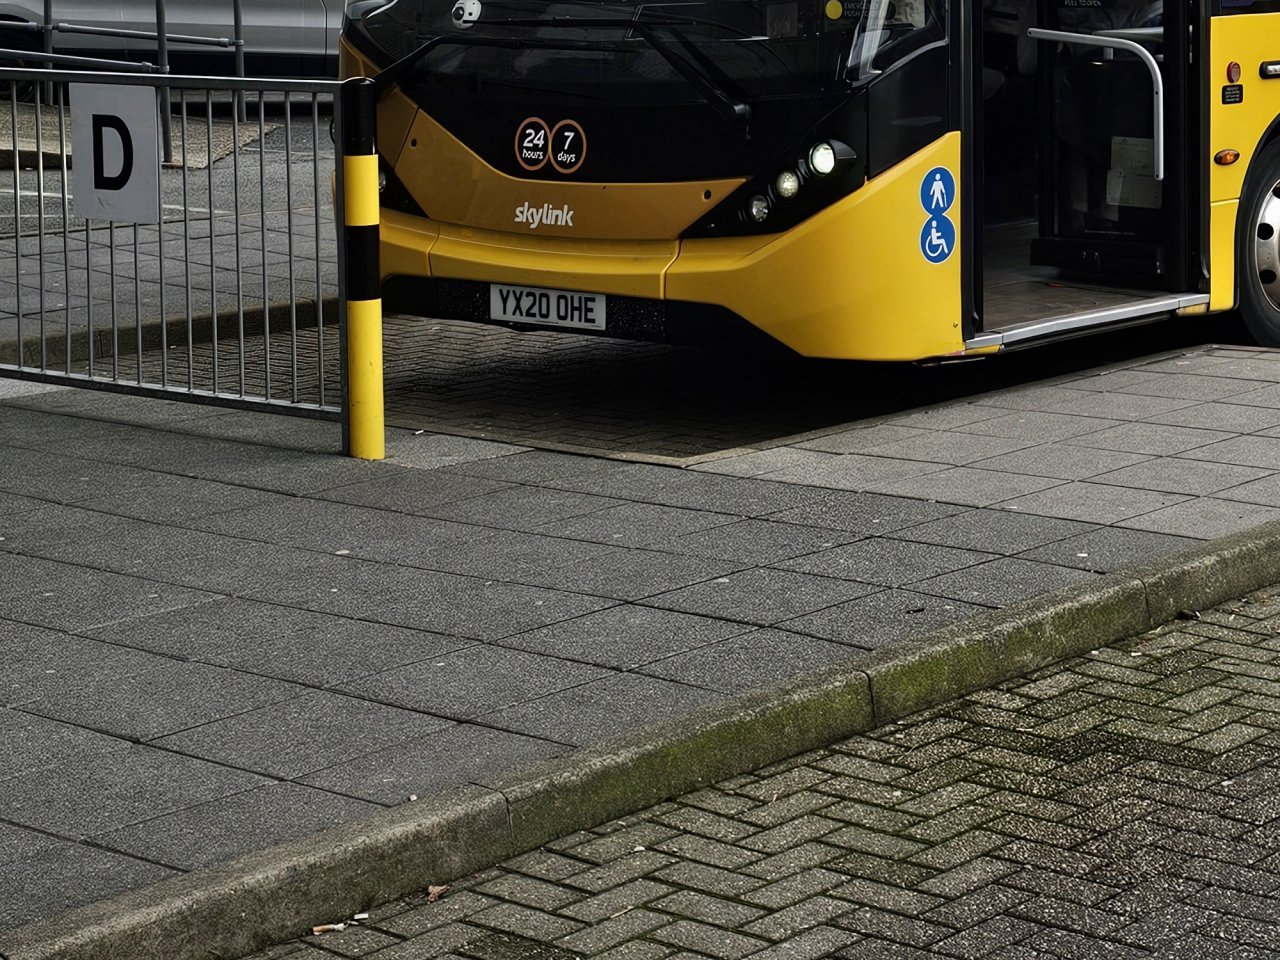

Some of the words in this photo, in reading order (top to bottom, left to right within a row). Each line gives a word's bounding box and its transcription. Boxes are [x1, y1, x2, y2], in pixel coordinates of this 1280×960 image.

[523, 129, 545, 147] 24
[564, 132, 575, 150] 7
[92, 114, 133, 190] D
[522, 149, 544, 159] hours
[557, 151, 576, 163] days
[514, 201, 575, 228] skylink
[499, 288, 551, 319] YX20
[556, 294, 596, 324] OHE
